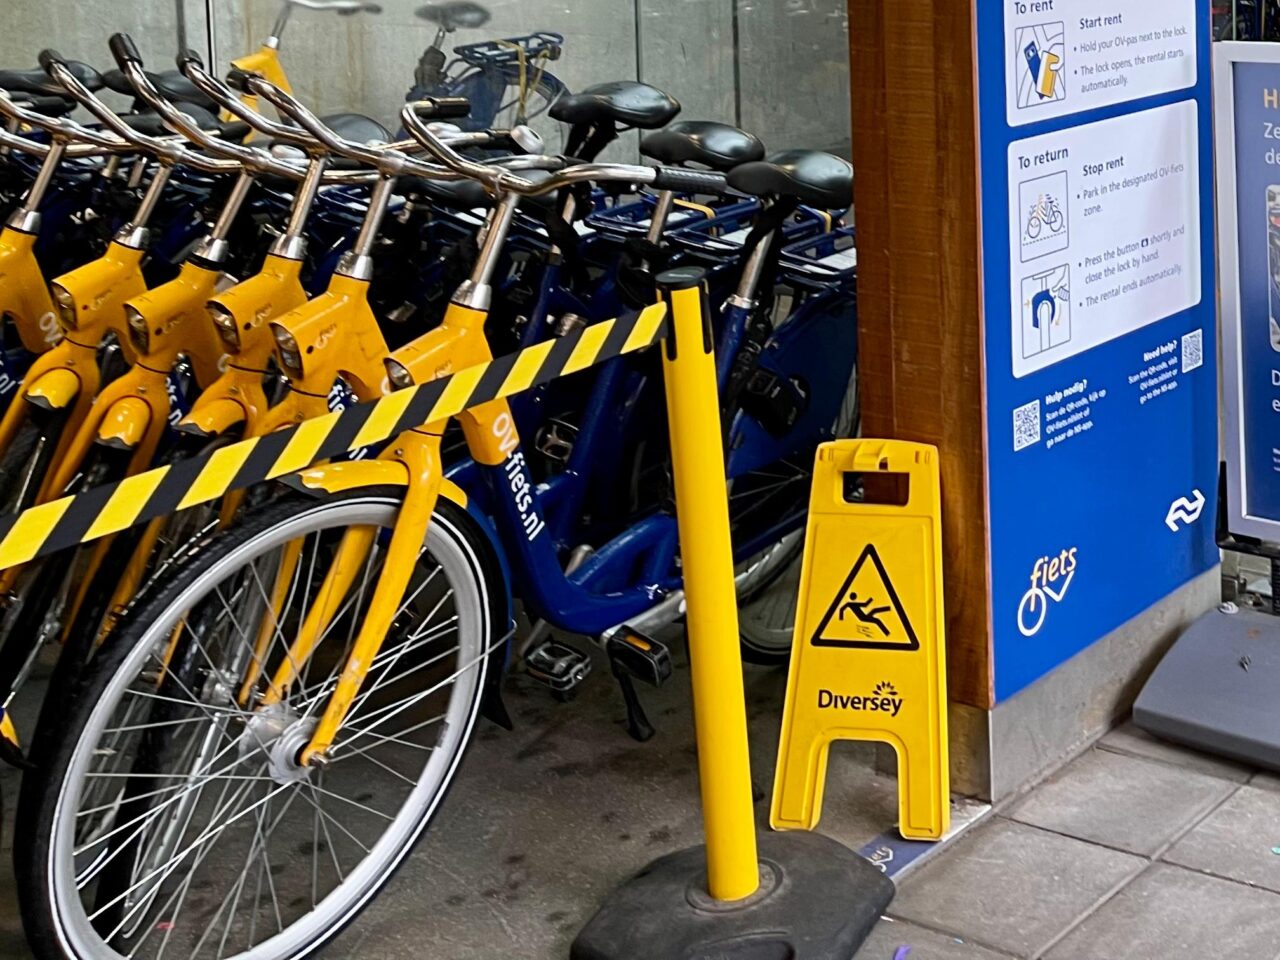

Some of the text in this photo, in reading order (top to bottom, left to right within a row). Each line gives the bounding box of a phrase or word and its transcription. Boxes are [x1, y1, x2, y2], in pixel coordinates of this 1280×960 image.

[1015, 2, 1026, 15] To
[1080, 13, 1122, 29] Start rent
[1080, 27, 1187, 52] Hold your OV-pas next to the lock.
[1081, 49, 1184, 76] The lock opens, the rental starts
[1018, 147, 1068, 170] To return
[1083, 156, 1124, 177] Stop rent
[1083, 162, 1184, 200] Park in the designated OV-fiets
[1083, 204, 1102, 216] zone.
[1085, 225, 1184, 268] Press the button shortly and
[1085, 251, 1159, 285] close the lock by hand.
[493, 412, 545, 541] OV-fiets.nl
[1031, 547, 1077, 612] fiets
[818, 689, 903, 717] Diversey
